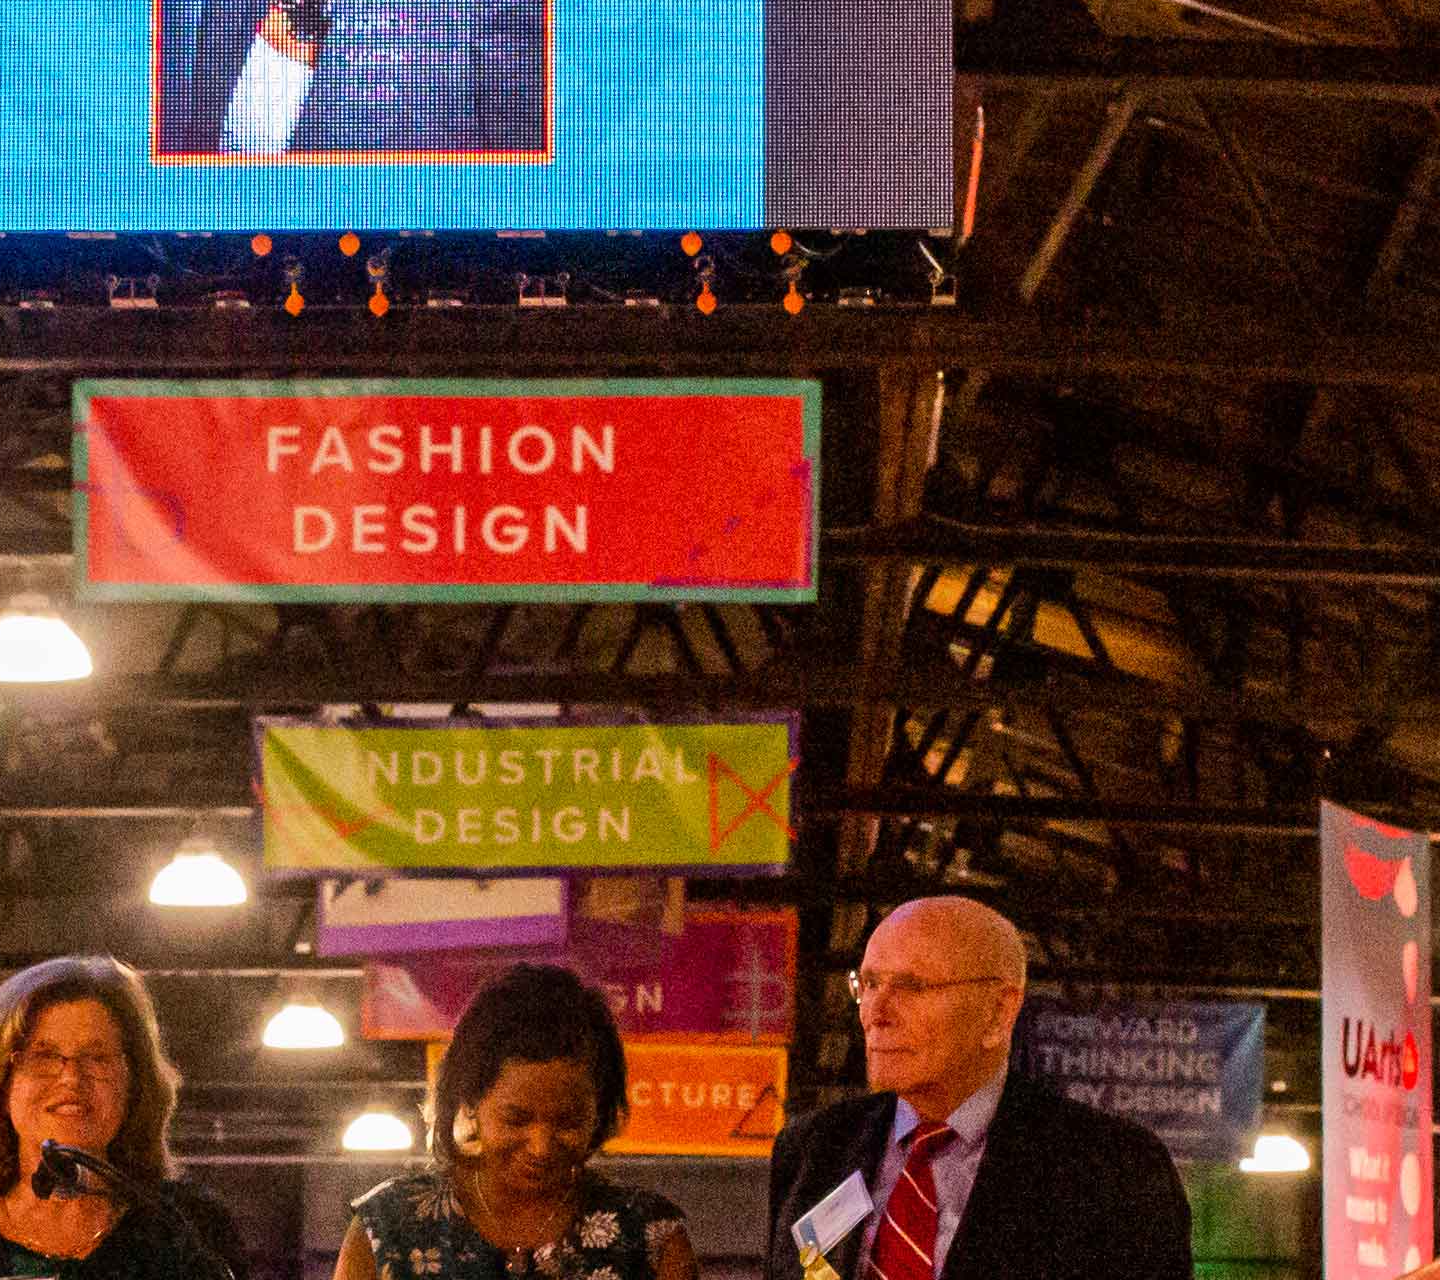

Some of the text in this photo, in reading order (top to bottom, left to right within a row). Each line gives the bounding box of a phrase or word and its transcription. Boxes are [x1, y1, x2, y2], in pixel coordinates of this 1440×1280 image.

[267, 425, 615, 473] FASHION
[293, 505, 588, 554] DESIGN
[366, 748, 700, 786] NDUSTRIAL
[415, 807, 631, 845] DESIGN
[1037, 1045, 1219, 1080] THINKING
[1114, 1084, 1223, 1114] DESIGN
